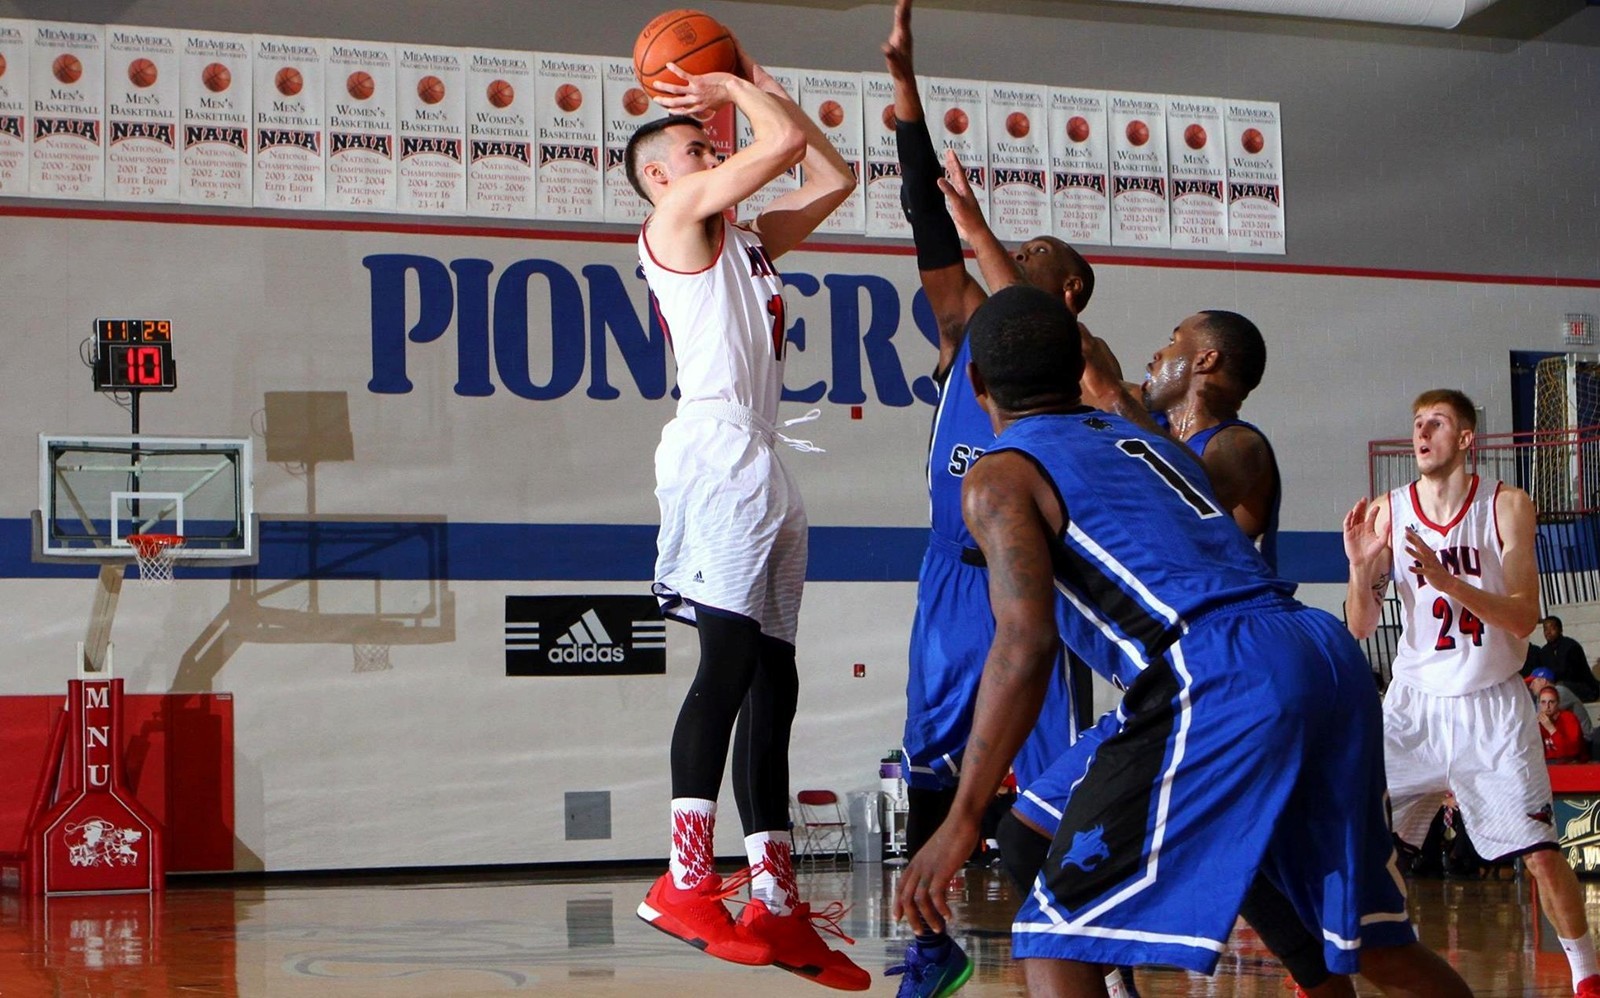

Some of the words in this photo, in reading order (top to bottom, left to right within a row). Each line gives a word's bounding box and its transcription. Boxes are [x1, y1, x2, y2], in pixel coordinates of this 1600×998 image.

[35, 118, 97, 141] NAIA
[111, 122, 173, 145] NAIA
[186, 126, 245, 149] NAIA
[259, 130, 318, 152] NAIA
[331, 133, 389, 156] NAIA
[402, 138, 460, 159] NAIA
[472, 140, 528, 162] NAIA
[540, 145, 597, 166] NAIA
[994, 169, 1044, 190] NAIA
[1054, 173, 1104, 193] NAIA
[1114, 176, 1163, 196] NAIA
[1173, 180, 1220, 200] NAIA
[1230, 182, 1278, 202] NAIA
[127, 347, 160, 384] 10
[1115, 438, 1222, 519] 1
[1432, 596, 1485, 650] 24
[547, 643, 625, 663] adidas
